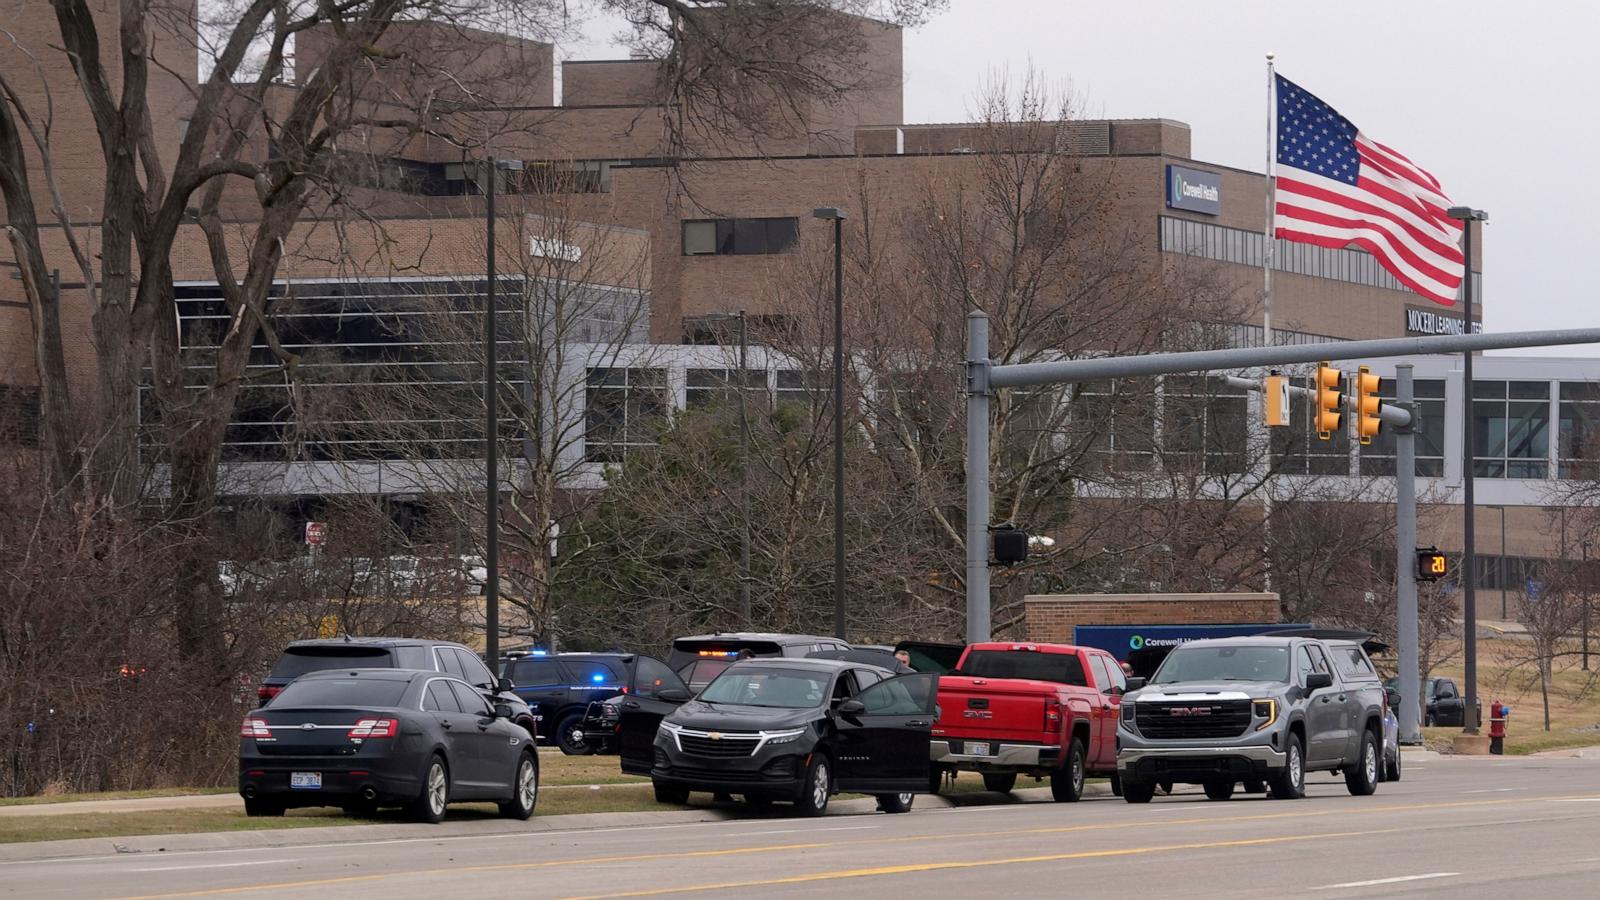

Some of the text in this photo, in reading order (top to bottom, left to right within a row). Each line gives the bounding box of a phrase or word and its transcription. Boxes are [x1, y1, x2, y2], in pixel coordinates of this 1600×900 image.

[1183, 181, 1218, 202] Corewell Health
[1408, 309, 1435, 334] MOCERI
[1435, 315, 1461, 335] LEARNING
[1432, 556, 1445, 572] 20
[1145, 637, 1183, 647] Corewell
[964, 710, 992, 718] GMC
[1169, 707, 1211, 716] GMC
